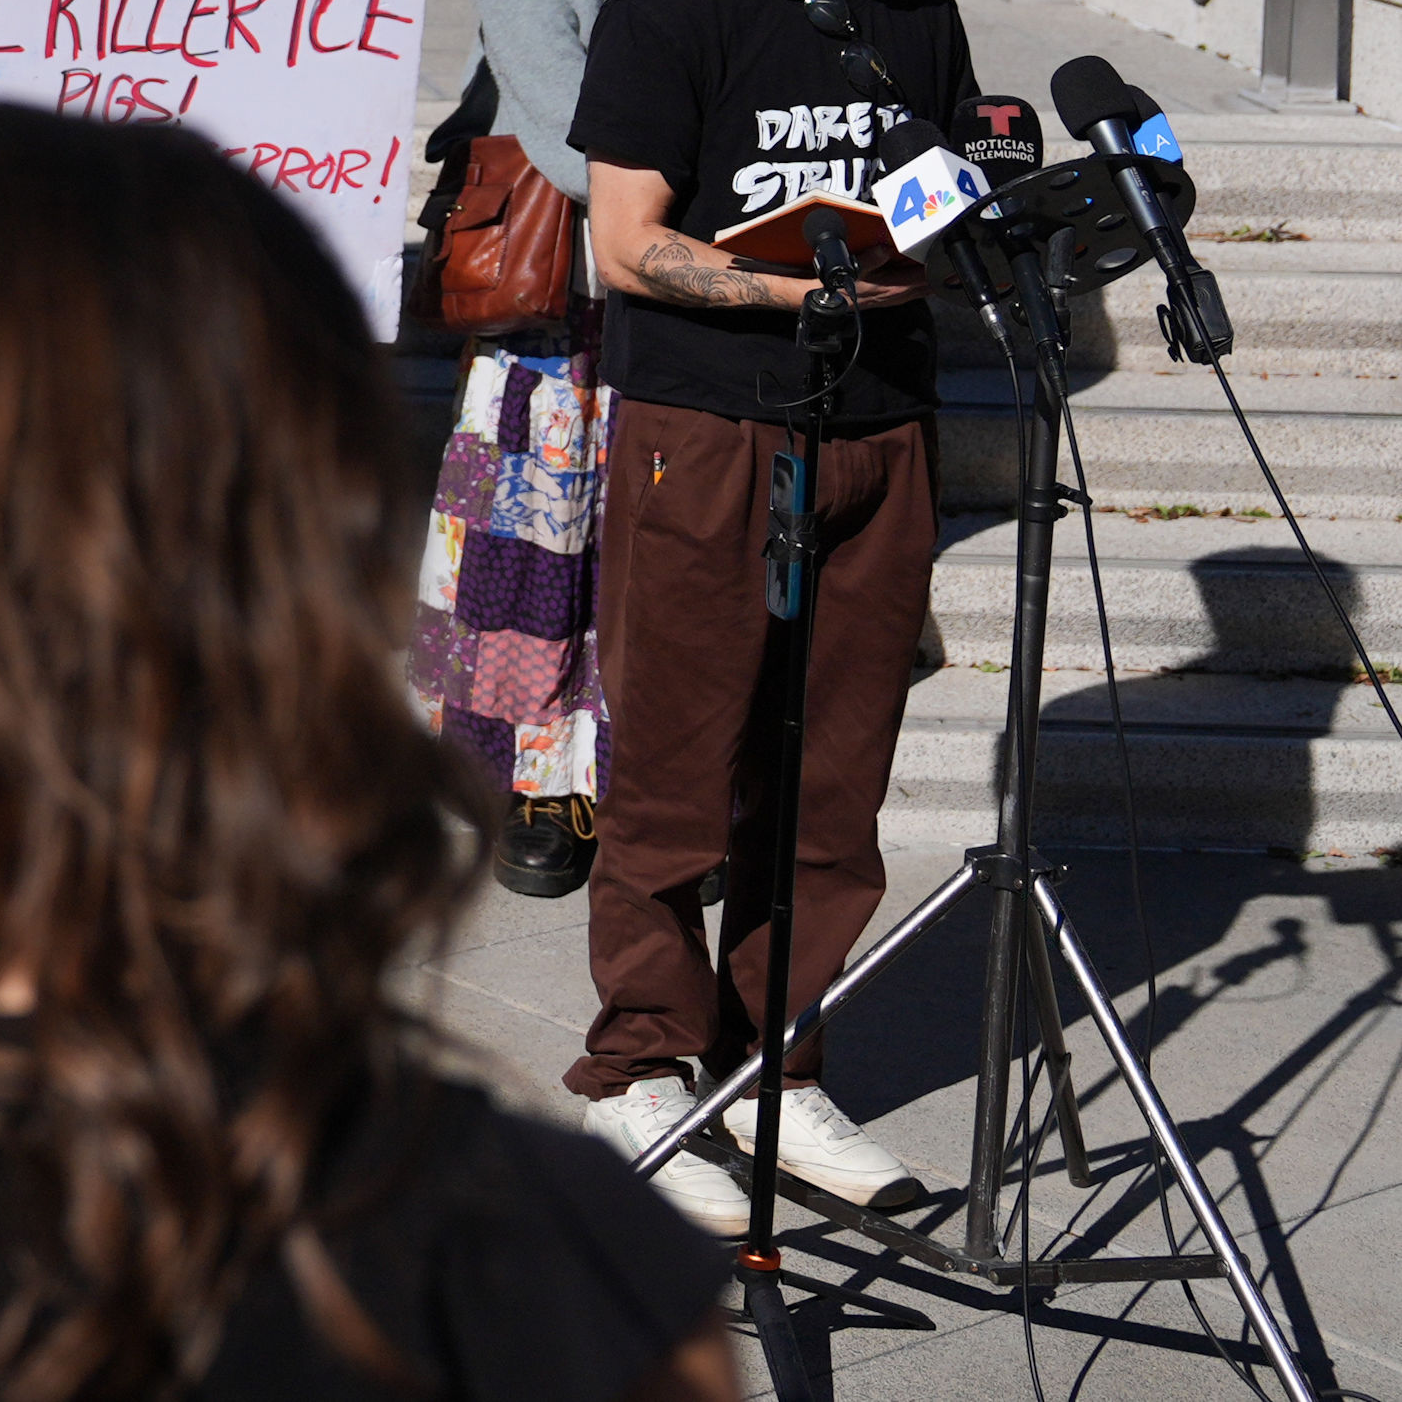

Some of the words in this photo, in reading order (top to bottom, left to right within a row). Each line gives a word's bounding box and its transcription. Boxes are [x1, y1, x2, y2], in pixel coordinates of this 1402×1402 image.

[55, 67, 199, 126] PIGS!
[755, 101, 875, 152] DARE
[964, 138, 1035, 154] NOTICIAS
[1140, 133, 1172, 157] LA
[208, 135, 401, 205] RROR!
[965, 151, 1035, 164] TELEMUNDO
[890, 175, 928, 229] 4
